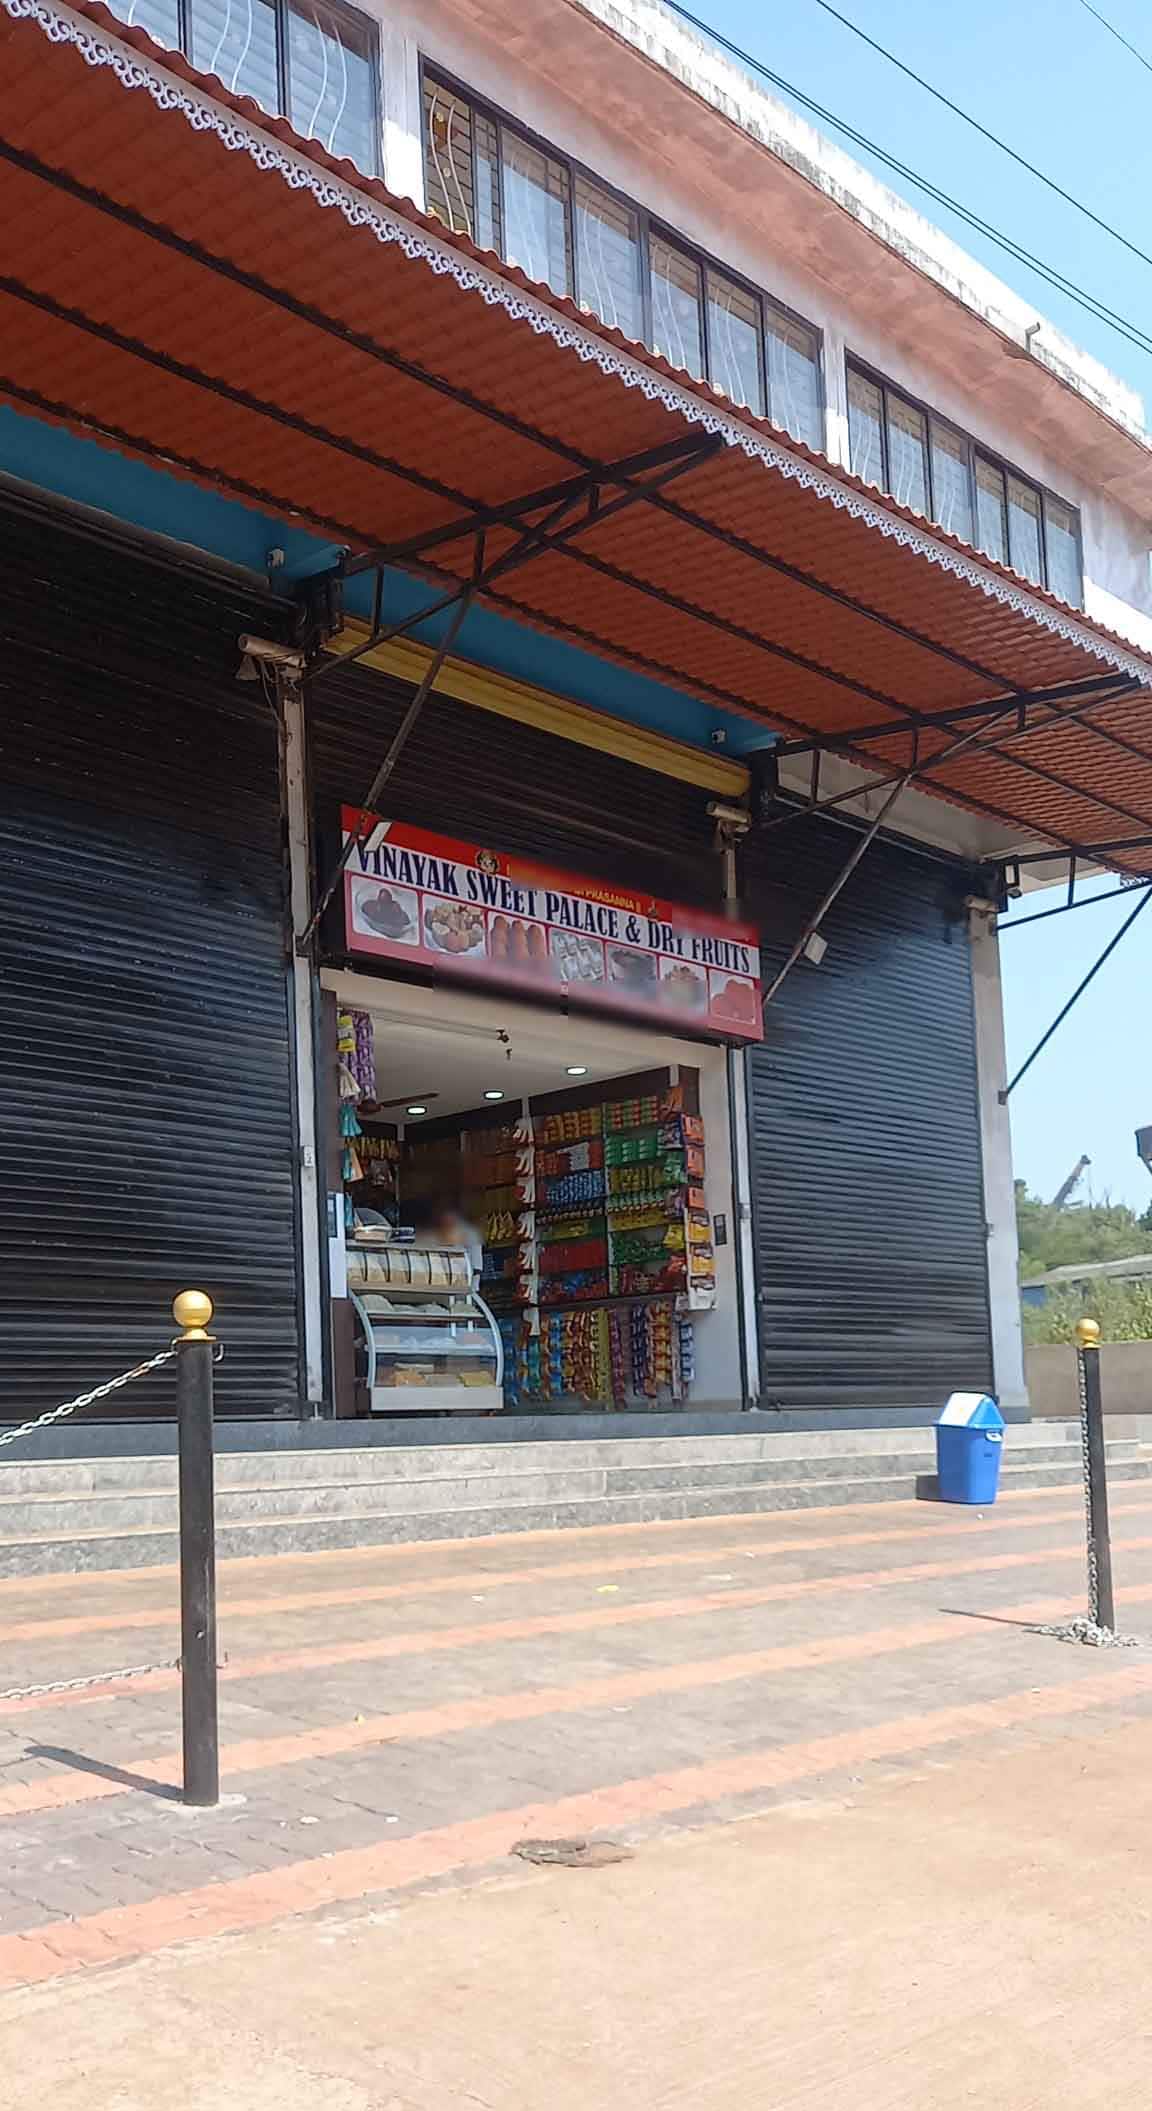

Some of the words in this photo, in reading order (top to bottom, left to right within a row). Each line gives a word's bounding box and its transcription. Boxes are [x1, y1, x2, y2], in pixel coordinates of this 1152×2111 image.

[357, 839, 459, 896] VINAYAK
[466, 869, 538, 917] SWEET
[545, 891, 619, 939] PALACE
[625, 915, 641, 944] &
[691, 935, 750, 974] FRUITS
